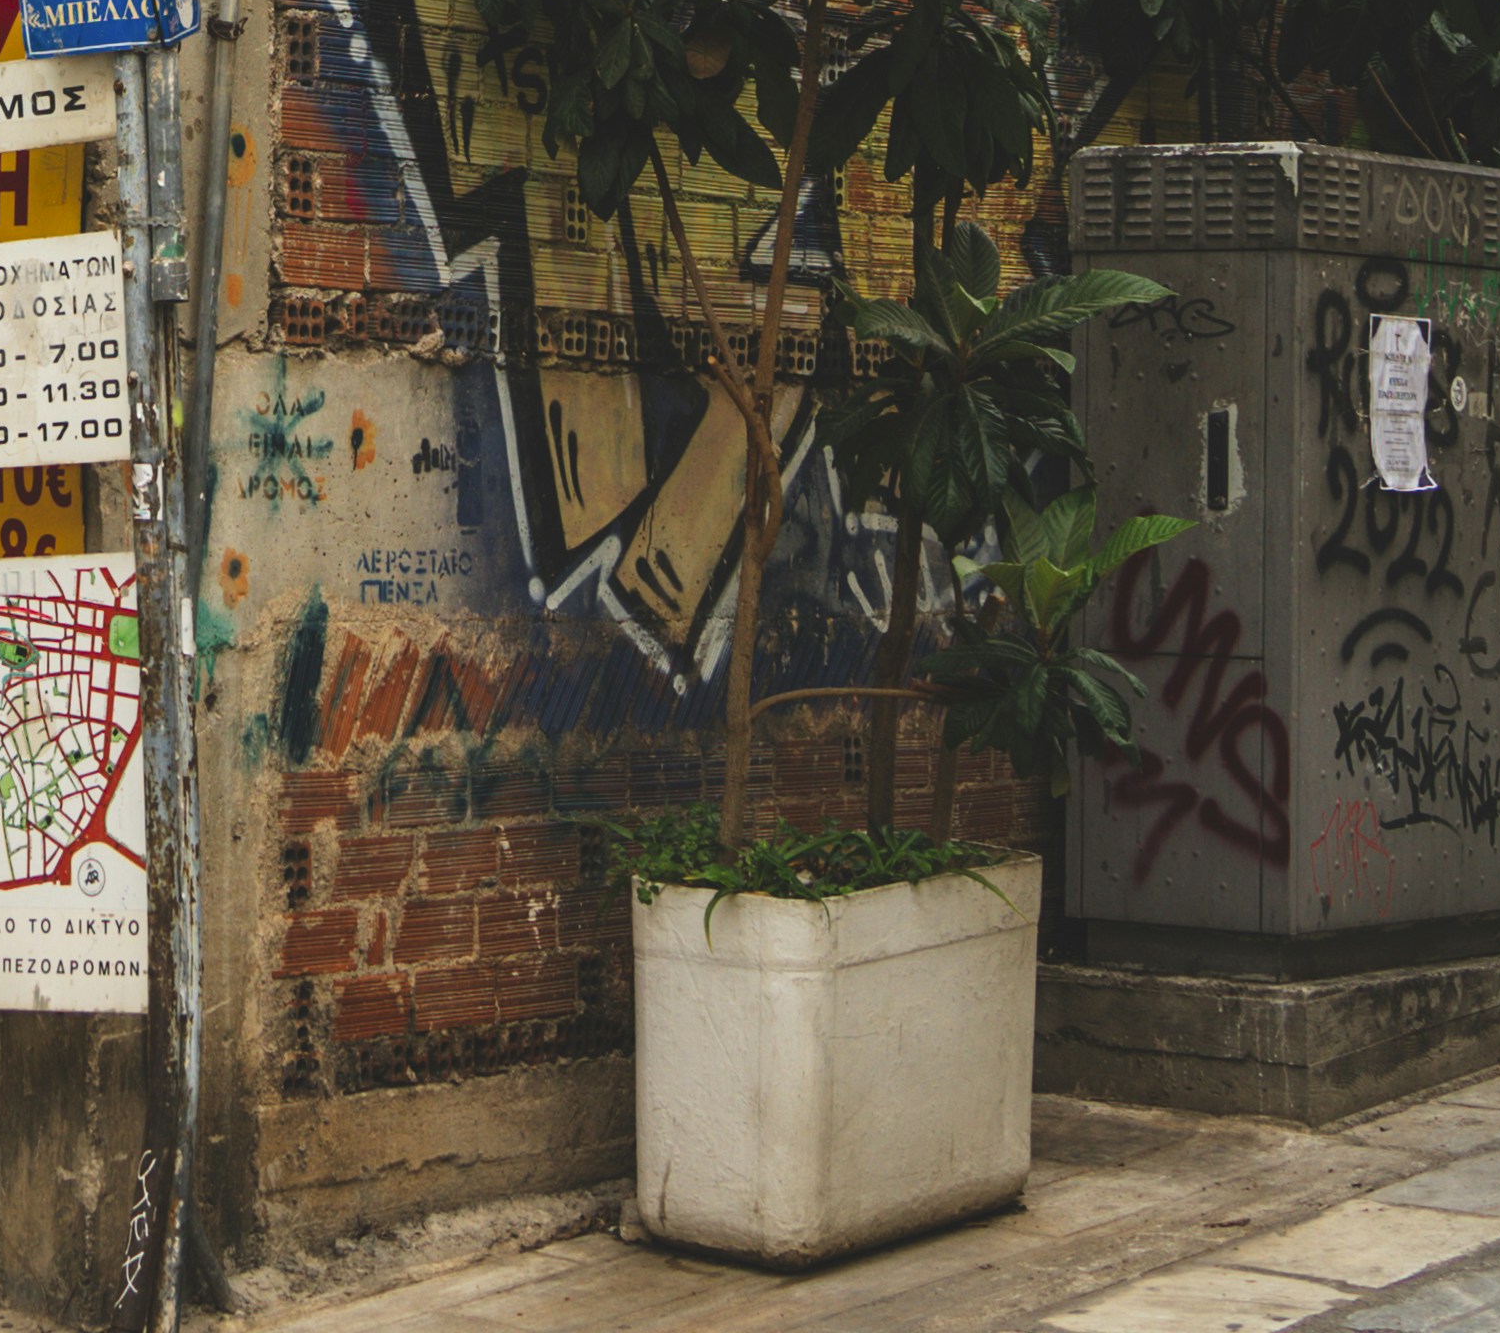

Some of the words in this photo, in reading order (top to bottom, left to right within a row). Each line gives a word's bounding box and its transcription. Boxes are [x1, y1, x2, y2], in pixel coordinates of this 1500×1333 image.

[49, 339, 120, 365] 7.00
[42, 378, 121, 405] 11.30
[36, 416, 123, 444] 17.00
[27, 916, 53, 935] ΤΟ
[64, 916, 141, 937] ΔΙΚΤΥΟ
[2, 955, 142, 978] ΠΕΖΟΔΡΟΜΩΝ
